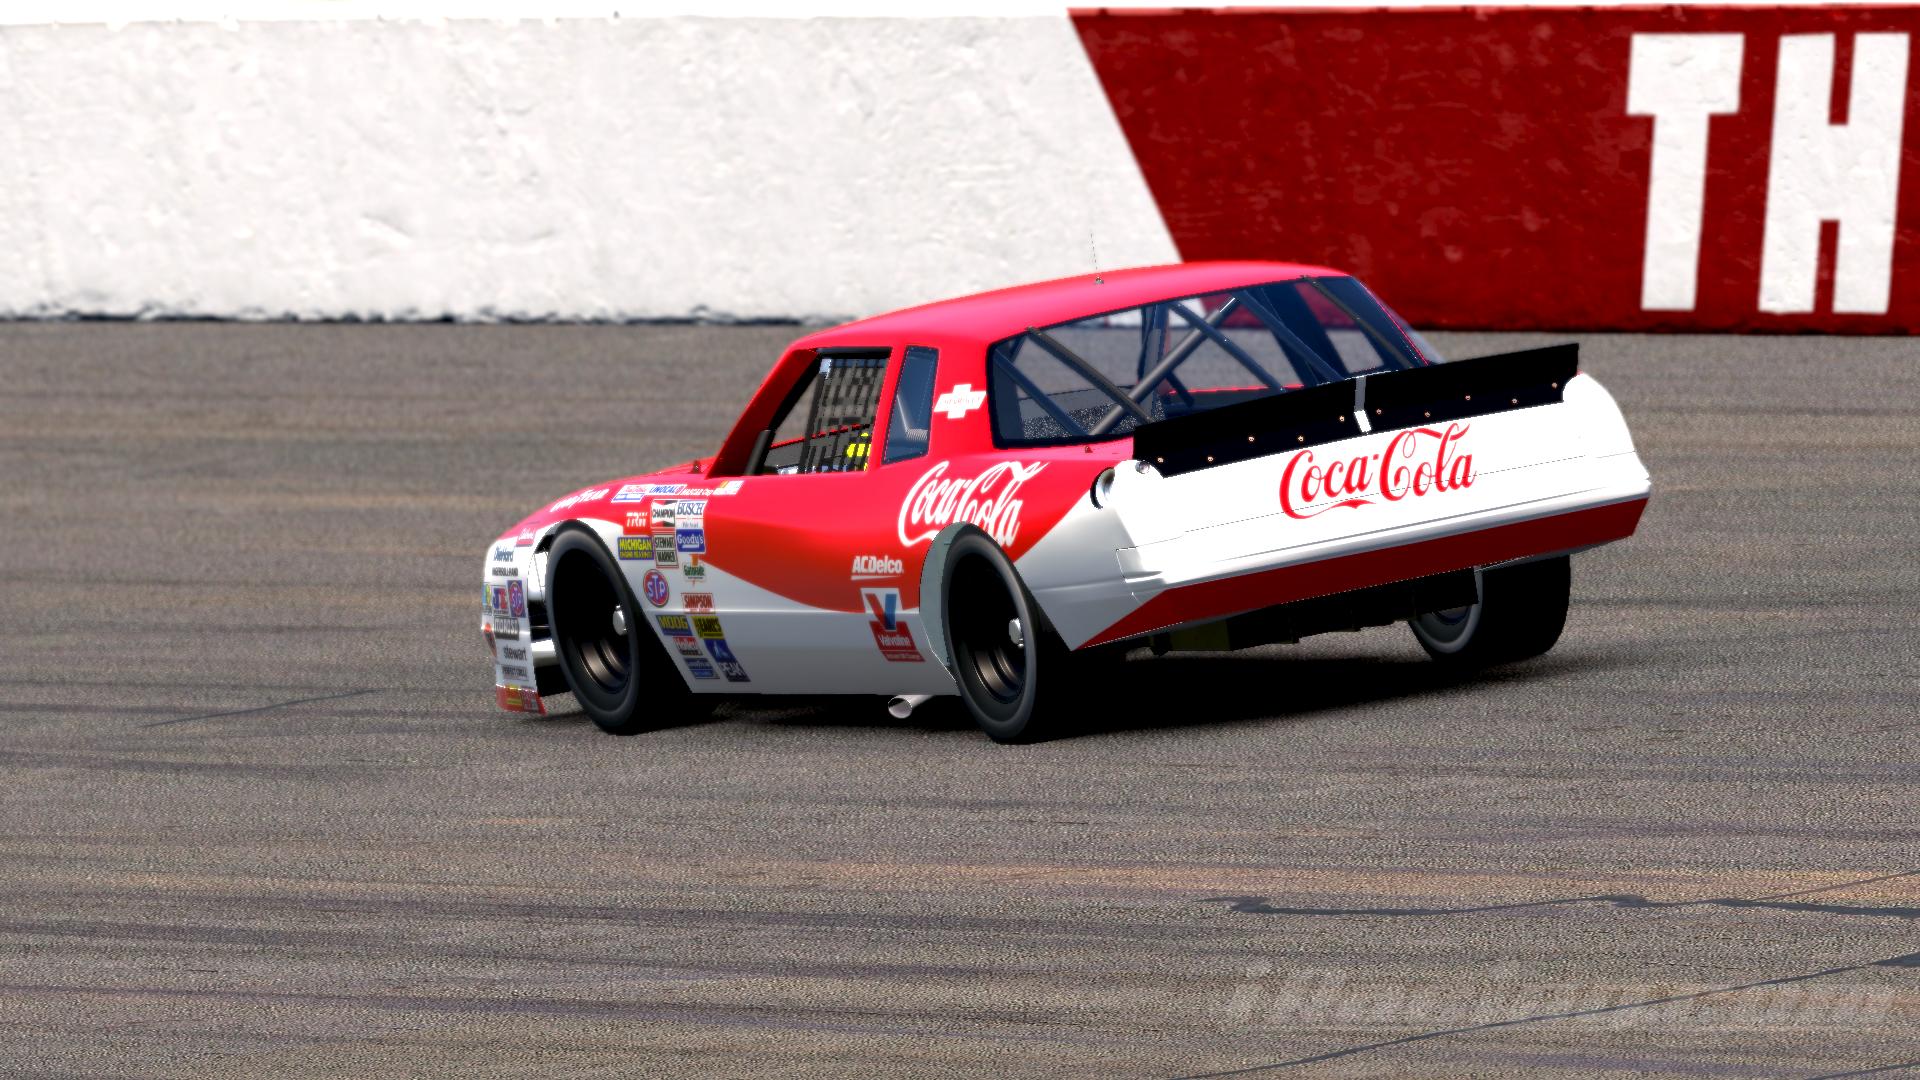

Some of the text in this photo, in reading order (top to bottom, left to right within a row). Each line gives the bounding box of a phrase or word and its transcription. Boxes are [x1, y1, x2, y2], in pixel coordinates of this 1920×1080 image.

[1279, 422, 1477, 519] Coca-Cola
[652, 508, 675, 519] CHAMPION
[677, 502, 705, 516] BUSCH
[626, 511, 649, 528] TRW
[619, 538, 653, 551] MICHIGAN
[677, 533, 704, 548] Goody's
[851, 554, 904, 574] ACDelco
[647, 574, 666, 602] STP
[684, 594, 714, 609] SIMPSON
[878, 634, 912, 647] Valvoline
